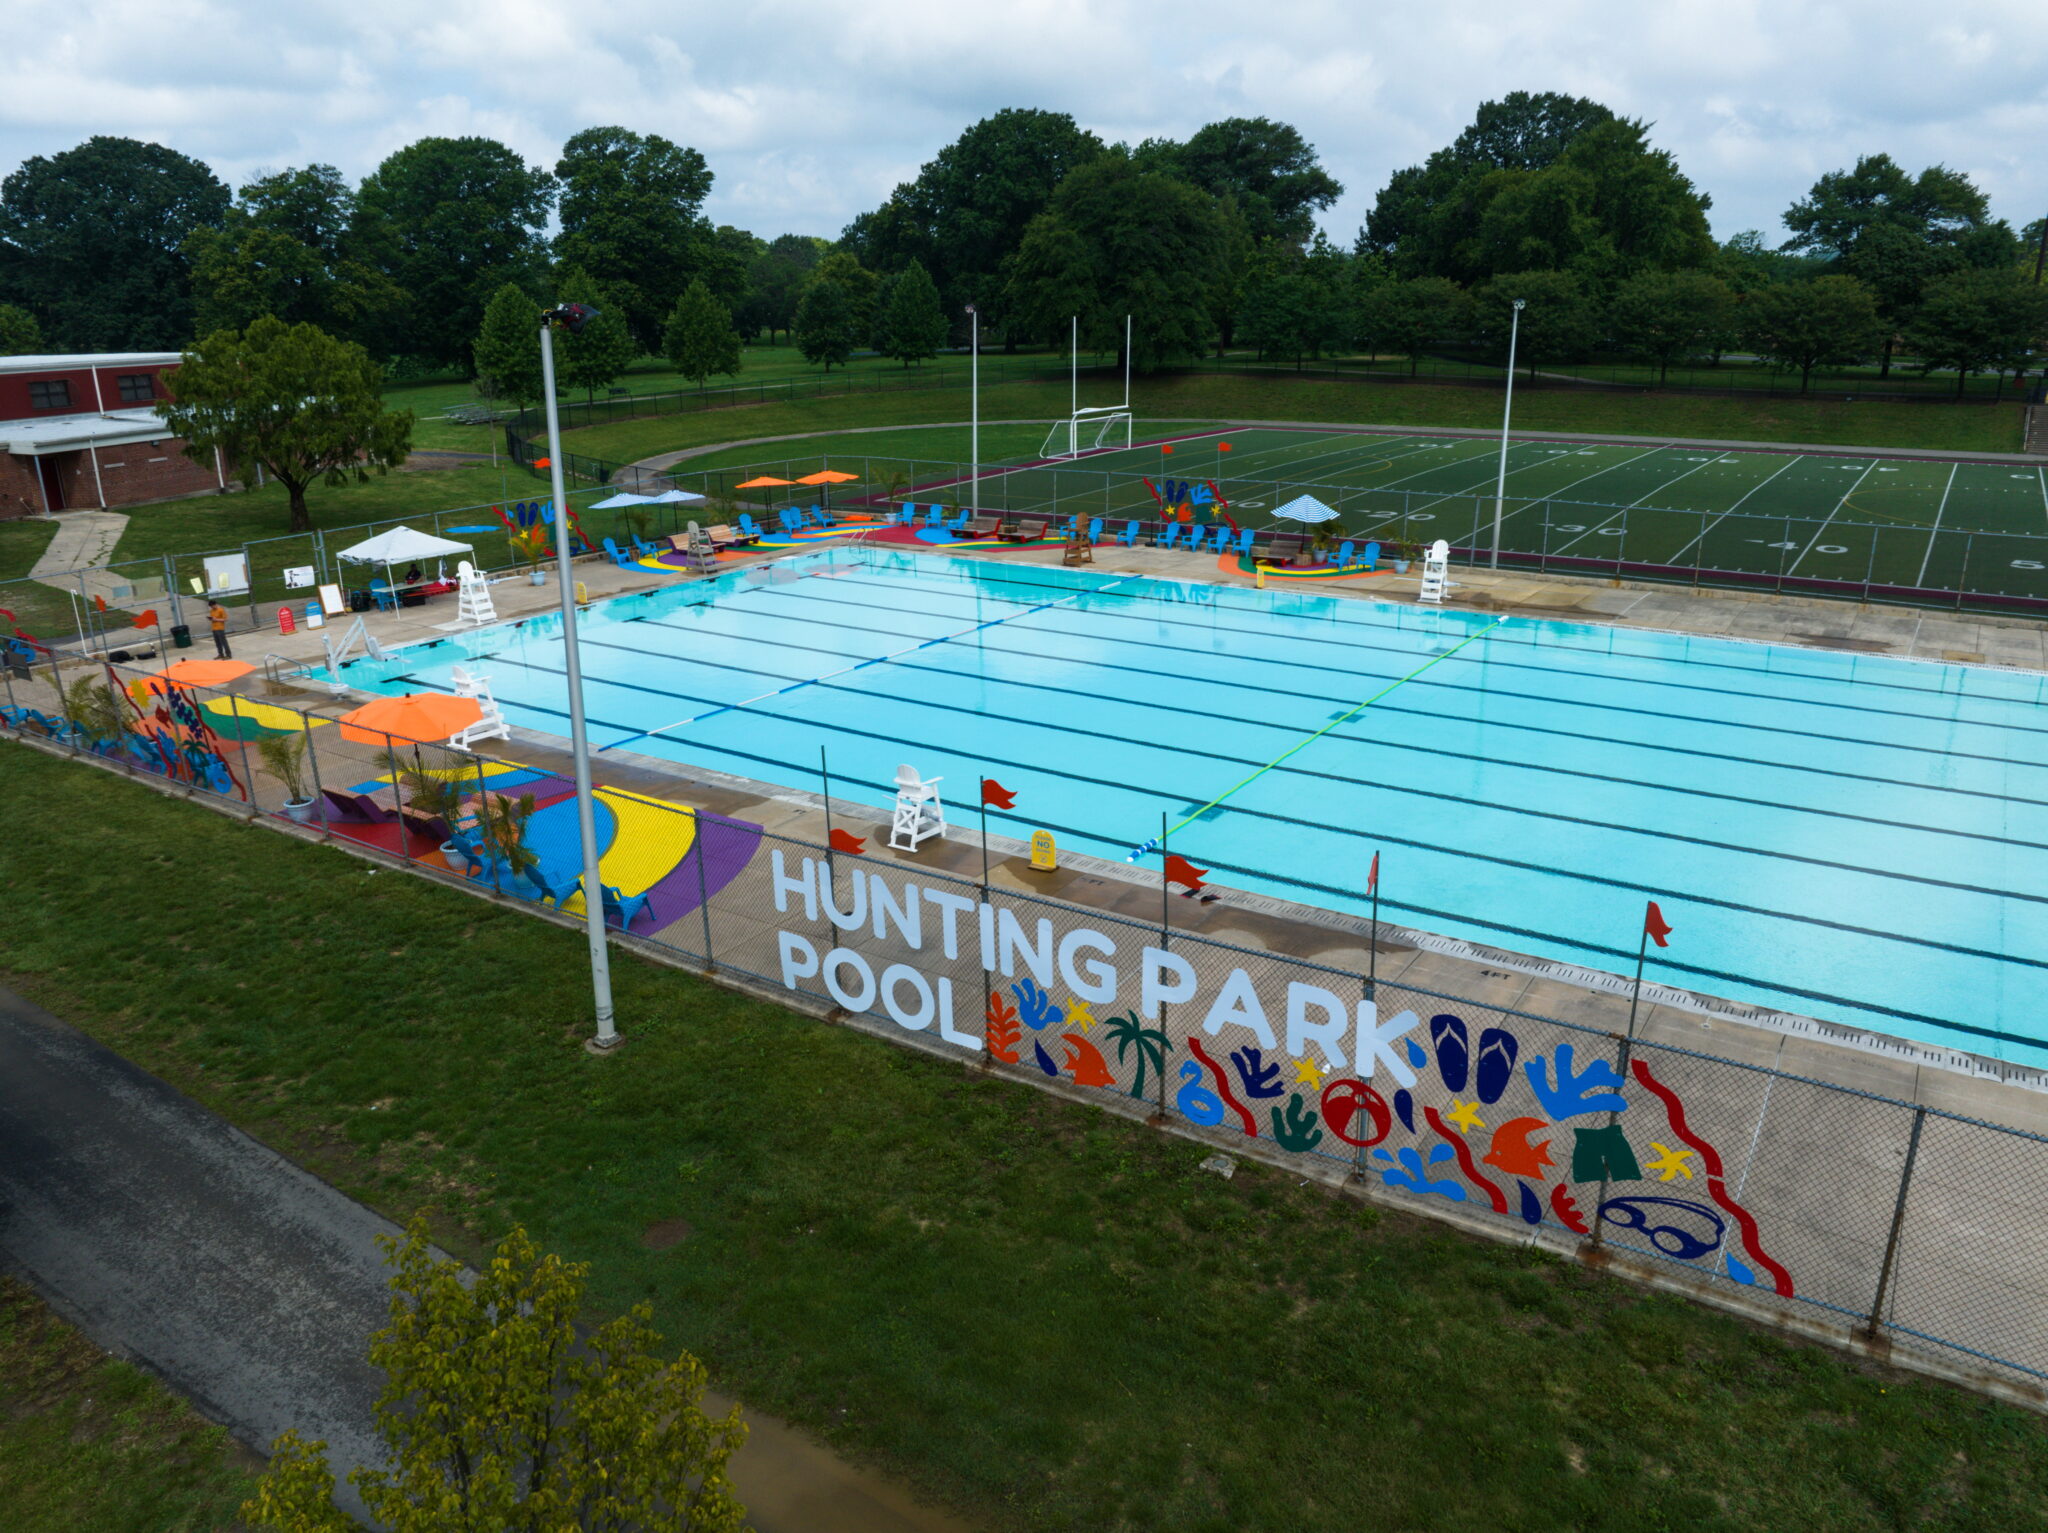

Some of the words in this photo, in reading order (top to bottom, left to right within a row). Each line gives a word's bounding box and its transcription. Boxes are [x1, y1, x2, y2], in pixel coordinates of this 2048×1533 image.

[1366, 510, 1437, 521] 20
[1555, 524, 1628, 536] 30
[1767, 541, 1849, 554] 40
[1036, 840, 1051, 850] NO
[771, 849, 1118, 1005] HUNTING
[1141, 945, 1420, 1089] PARK
[778, 930, 982, 1051] POOL
